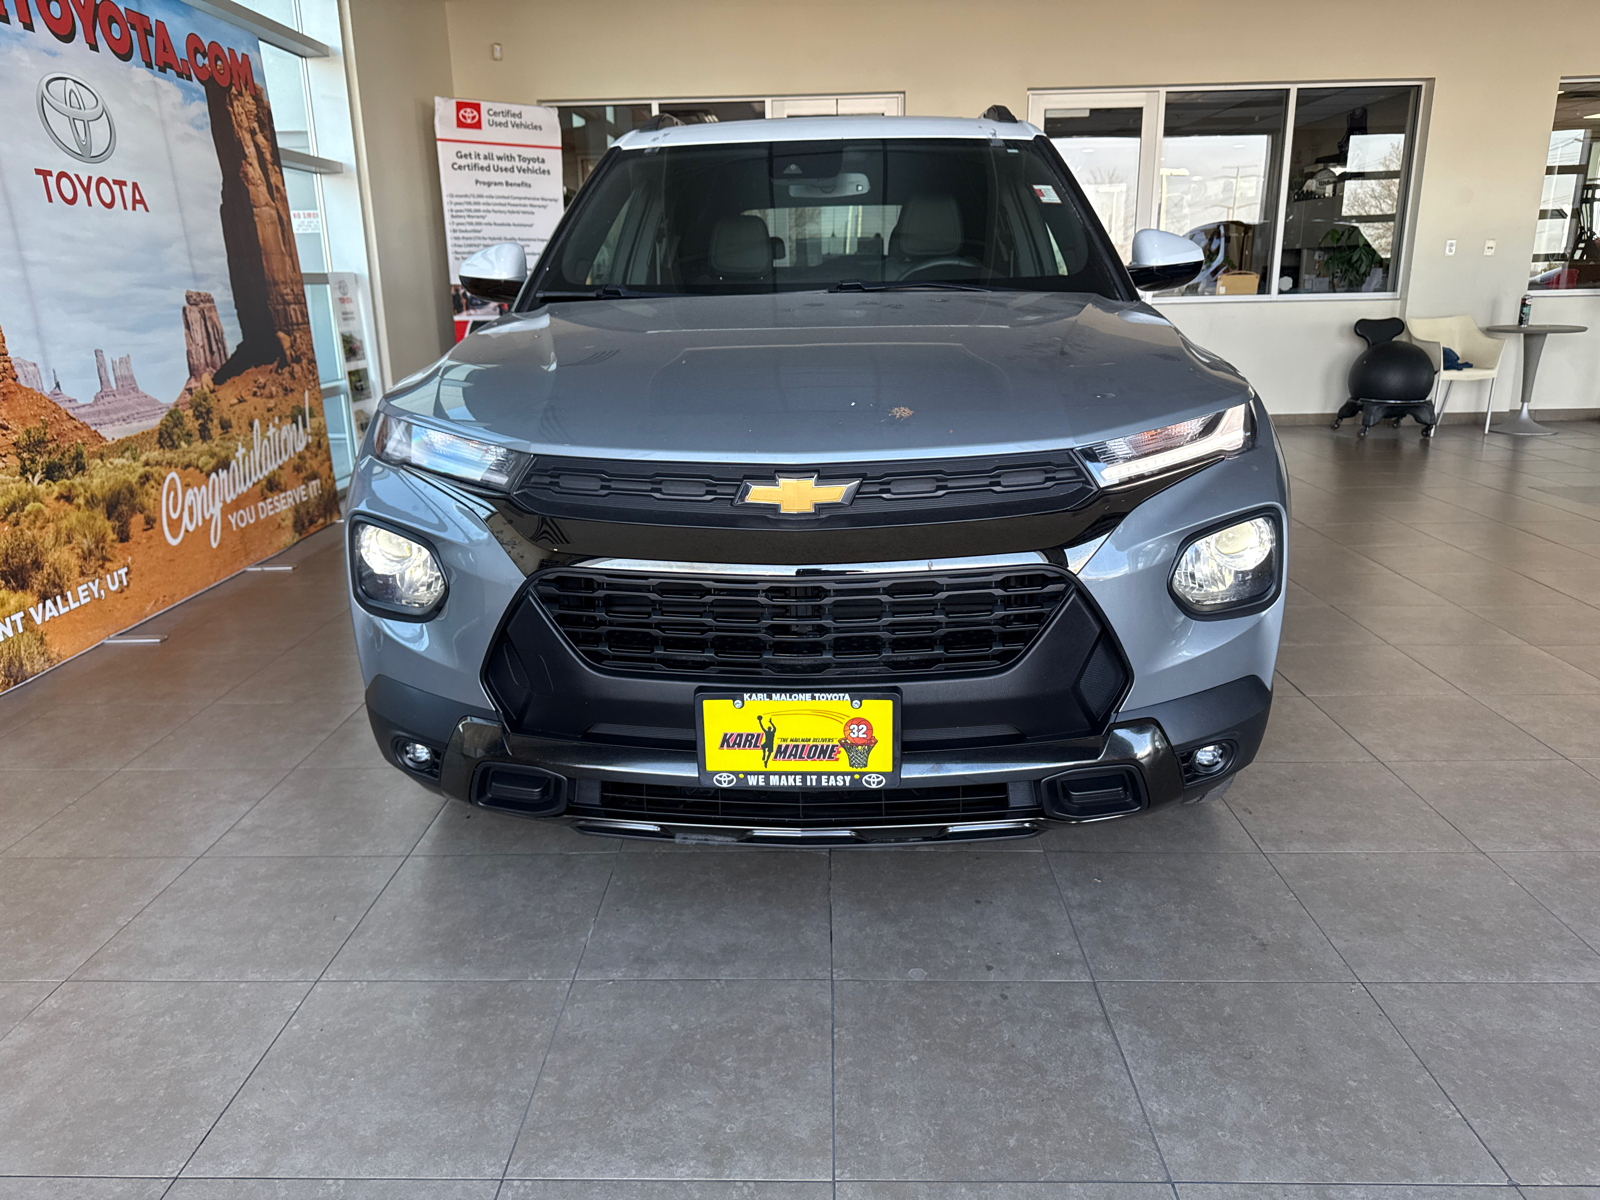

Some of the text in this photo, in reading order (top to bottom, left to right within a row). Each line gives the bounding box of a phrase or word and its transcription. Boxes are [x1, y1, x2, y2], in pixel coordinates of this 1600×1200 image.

[487, 108, 522, 119] Certified
[487, 119, 543, 131] Used Vehicles
[455, 151, 546, 165] Get it all with Toyota
[451, 162, 551, 176] Certified Used Vehicles
[34, 168, 150, 213] TOYOTA
[475, 179, 532, 189] Program Benefits
[162, 389, 312, 548] Congratulations!
[228, 478, 322, 531] YOU DESERVE IT!
[28, 578, 105, 626] VALLEY,
[106, 566, 128, 592] UT
[743, 693, 850, 702] KARL MALONE TOYOTA
[849, 724, 867, 738] 32
[718, 732, 763, 750] KARL
[772, 743, 841, 762] MALONE
[747, 775, 851, 786] WE MAKE IT EASY
